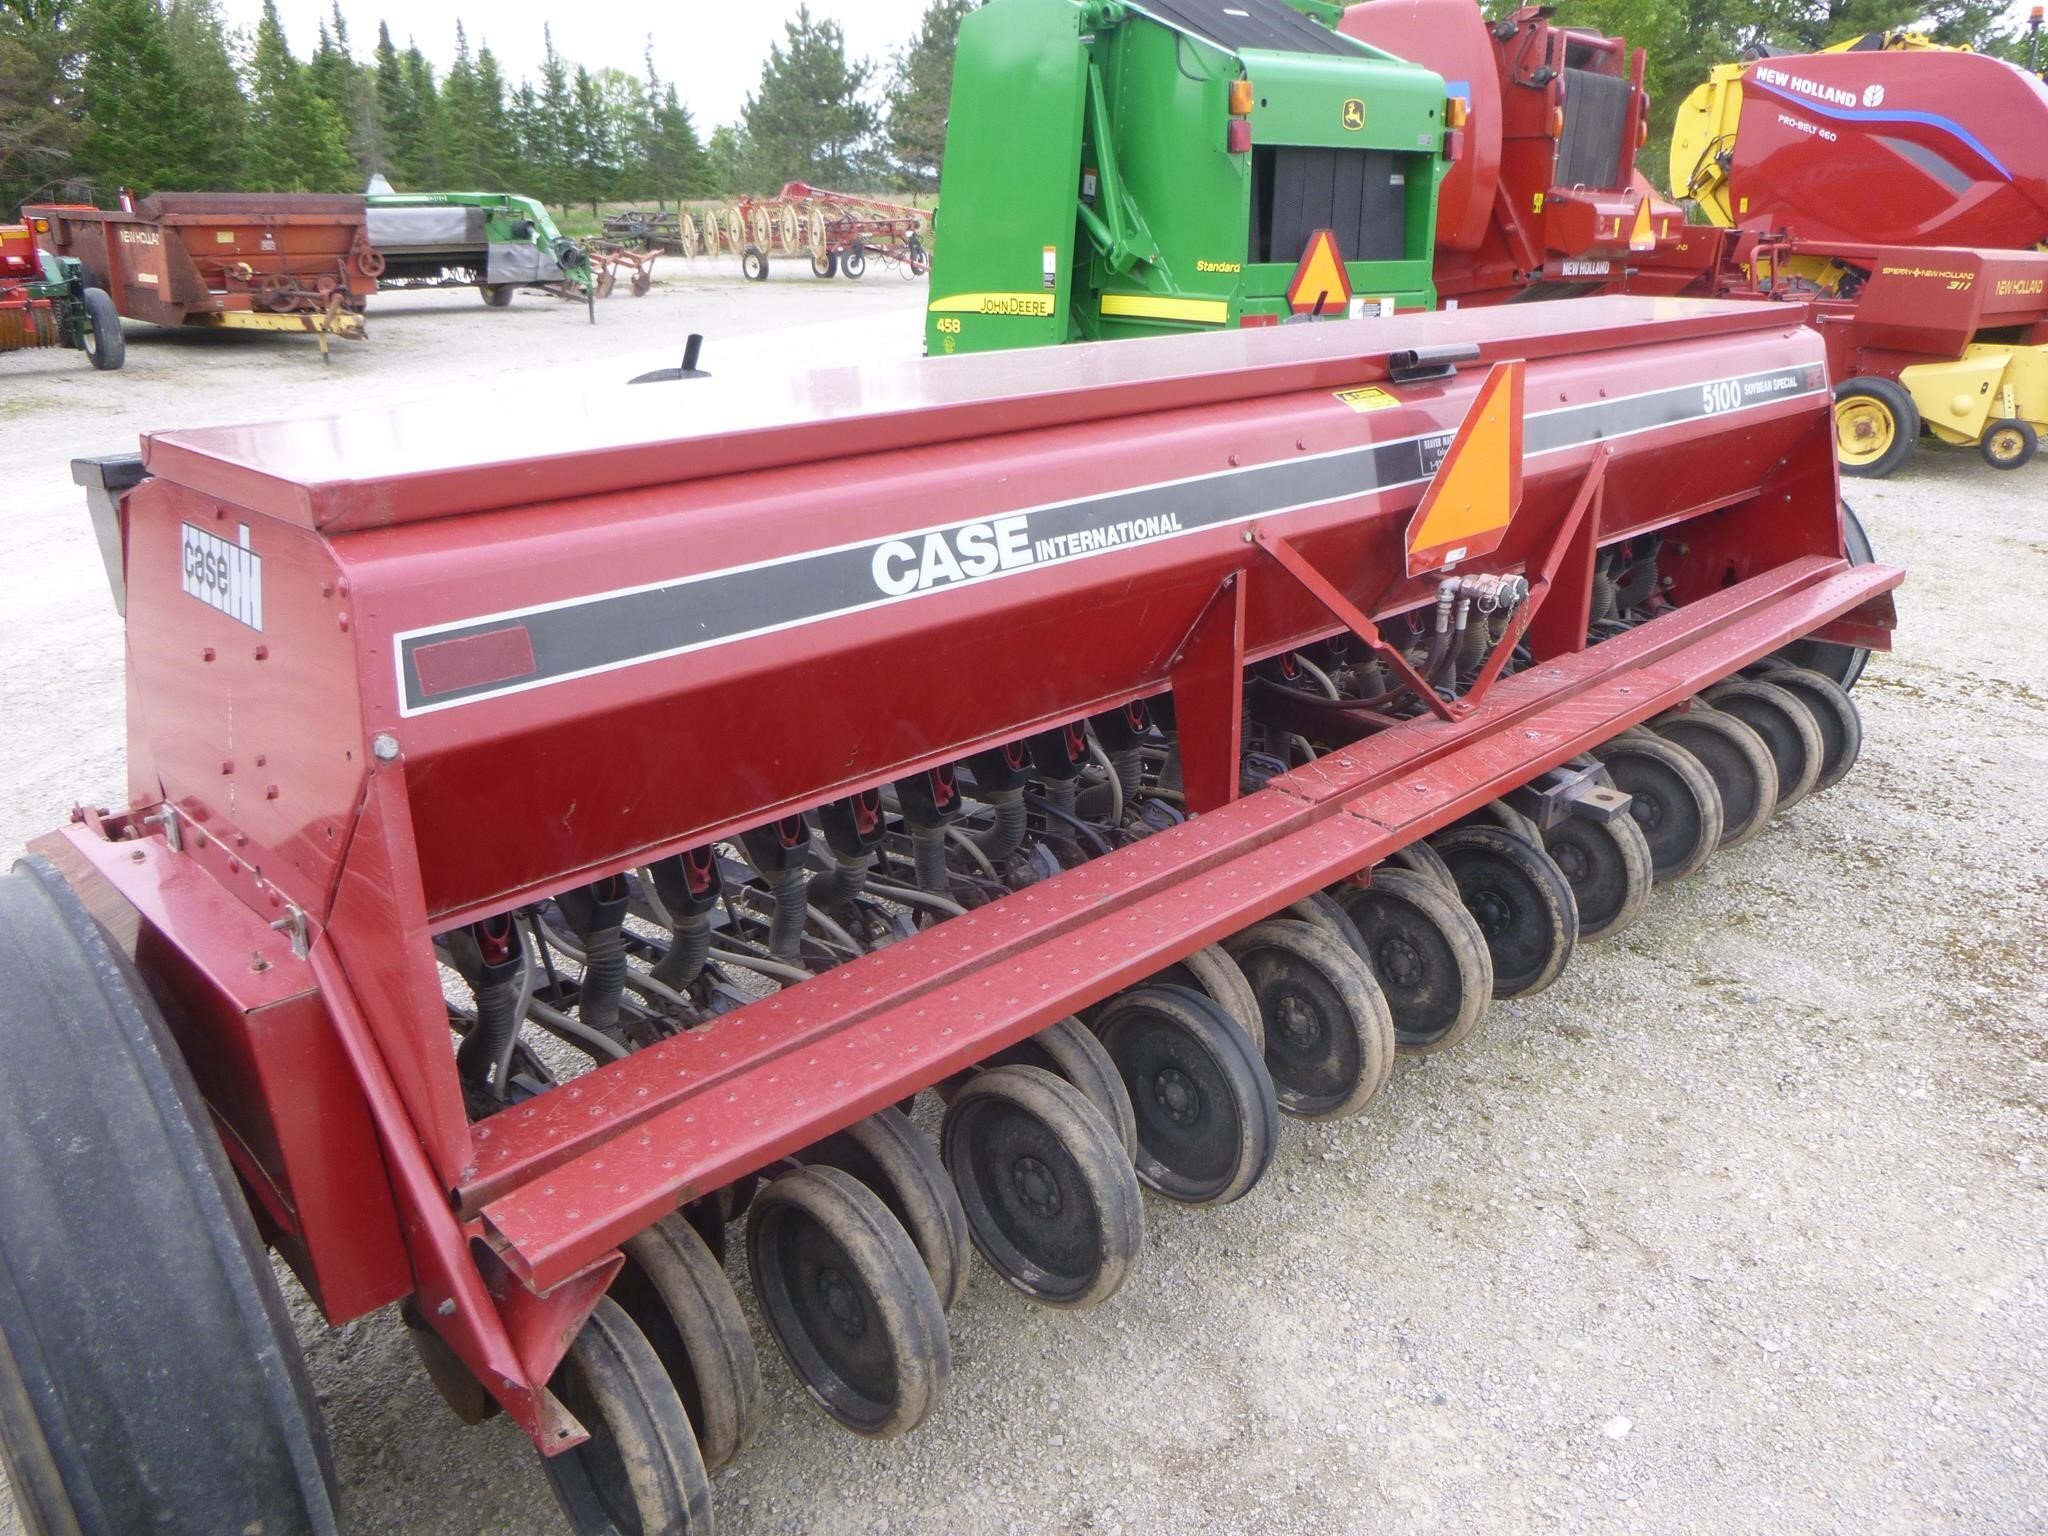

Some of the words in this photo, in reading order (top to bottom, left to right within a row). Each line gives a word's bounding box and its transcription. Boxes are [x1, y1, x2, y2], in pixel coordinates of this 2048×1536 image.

[1756, 66, 1789, 87] NEW
[1791, 76, 1857, 108] HOLLAND
[1778, 114, 1817, 134] PRO-BELT
[120, 230, 136, 243] NEW
[1196, 260, 1240, 273] Standard
[1562, 261, 1579, 276] NEW
[1579, 261, 1610, 276] HOLLAND
[1882, 267, 1912, 277] SPERRY
[1921, 270, 1938, 278] NEW
[1939, 271, 1975, 280] HOLLAND
[1947, 281, 1972, 291] 311
[1996, 281, 2013, 296] NEW
[2013, 280, 2044, 295] HOLLAND
[980, 297, 1009, 312] JOHN
[1010, 298, 1047, 314] DEERE
[937, 318, 961, 333] 458
[1702, 380, 1741, 413] 5100
[1744, 381, 1773, 396] SOYBEAN
[1773, 376, 1798, 390] SPECIAL
[872, 515, 1034, 596] CASE
[1035, 512, 1182, 562] INTERNATIONAL
[184, 539, 228, 597] case
